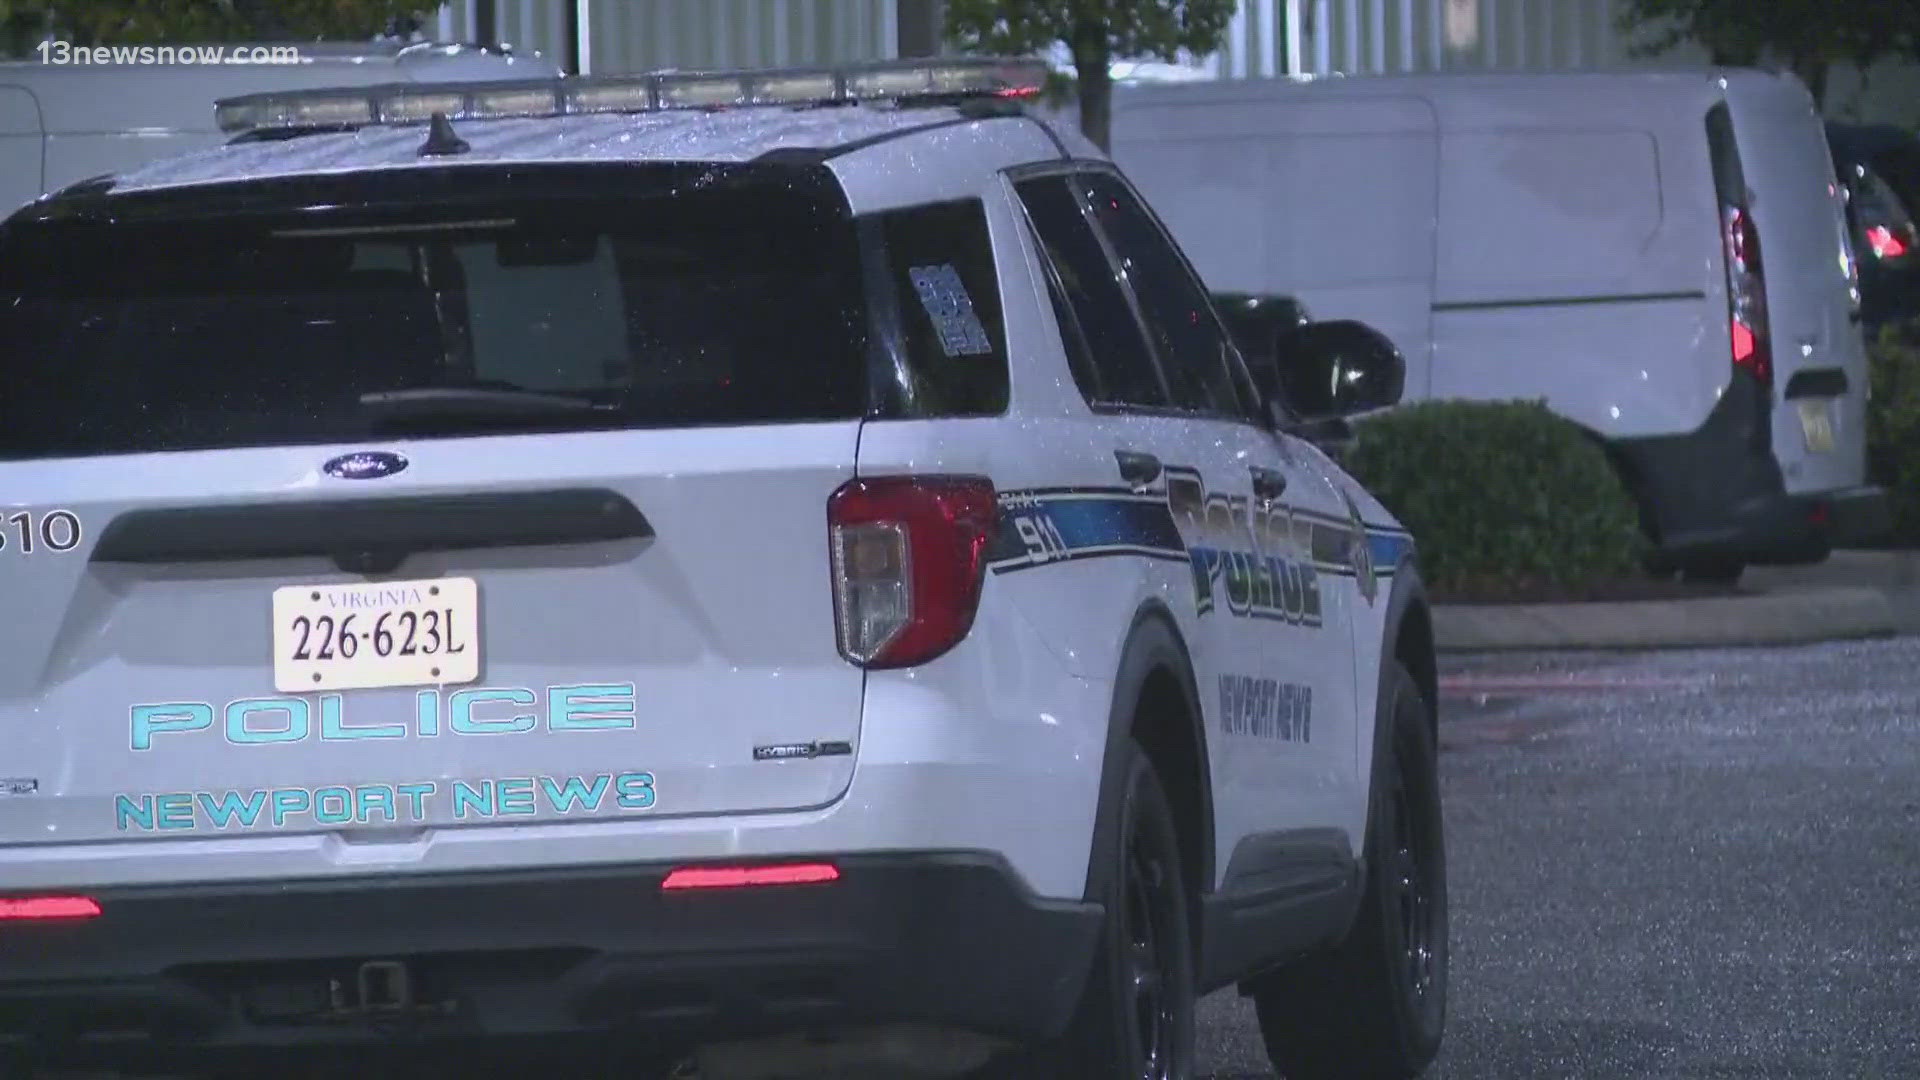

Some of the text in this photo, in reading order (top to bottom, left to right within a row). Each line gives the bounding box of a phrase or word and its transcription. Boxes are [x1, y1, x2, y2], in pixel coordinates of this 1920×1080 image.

[0, 509, 82, 554] 10
[1015, 515, 1072, 563] 911
[1164, 465, 1322, 628] POLICE
[328, 588, 422, 608] VIRGINIA
[291, 608, 465, 660] 226-623L
[128, 682, 637, 751] POLICE
[114, 771, 657, 832] NEWPORT NEWS
